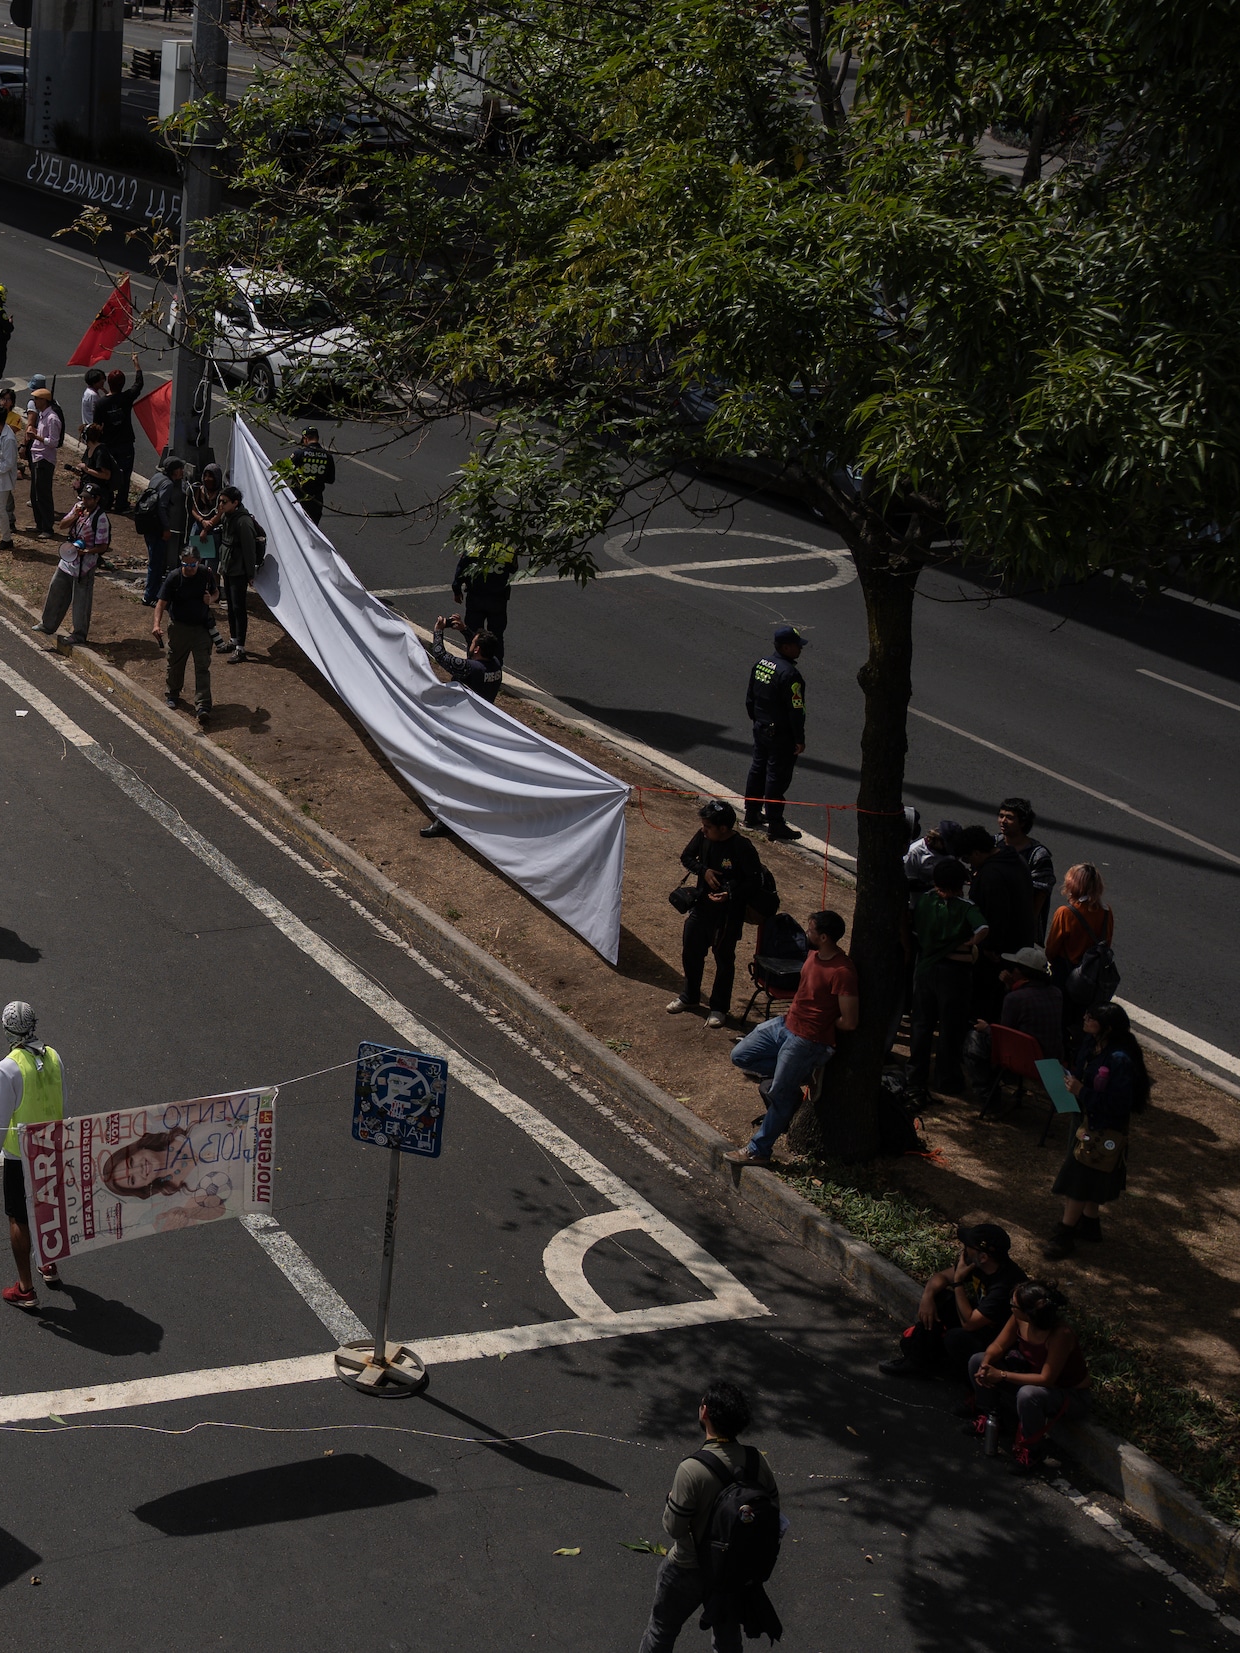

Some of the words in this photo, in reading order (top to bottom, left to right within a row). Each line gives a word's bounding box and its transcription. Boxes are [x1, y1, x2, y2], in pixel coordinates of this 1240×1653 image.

[303, 463, 326, 475] SSC
[756, 670, 771, 684] SSC
[111, 1114, 119, 1144] VOTA
[263, 1112, 273, 1123] PT
[385, 1121, 431, 1142] ENAH
[82, 1120, 92, 1181] GOBIERNO
[257, 1126, 273, 1203] morena
[33, 1122, 63, 1259] CLARA
[64, 1121, 80, 1246] BRUGADA
[84, 1186, 92, 1202] DE
[85, 1206, 94, 1236] JEFA
